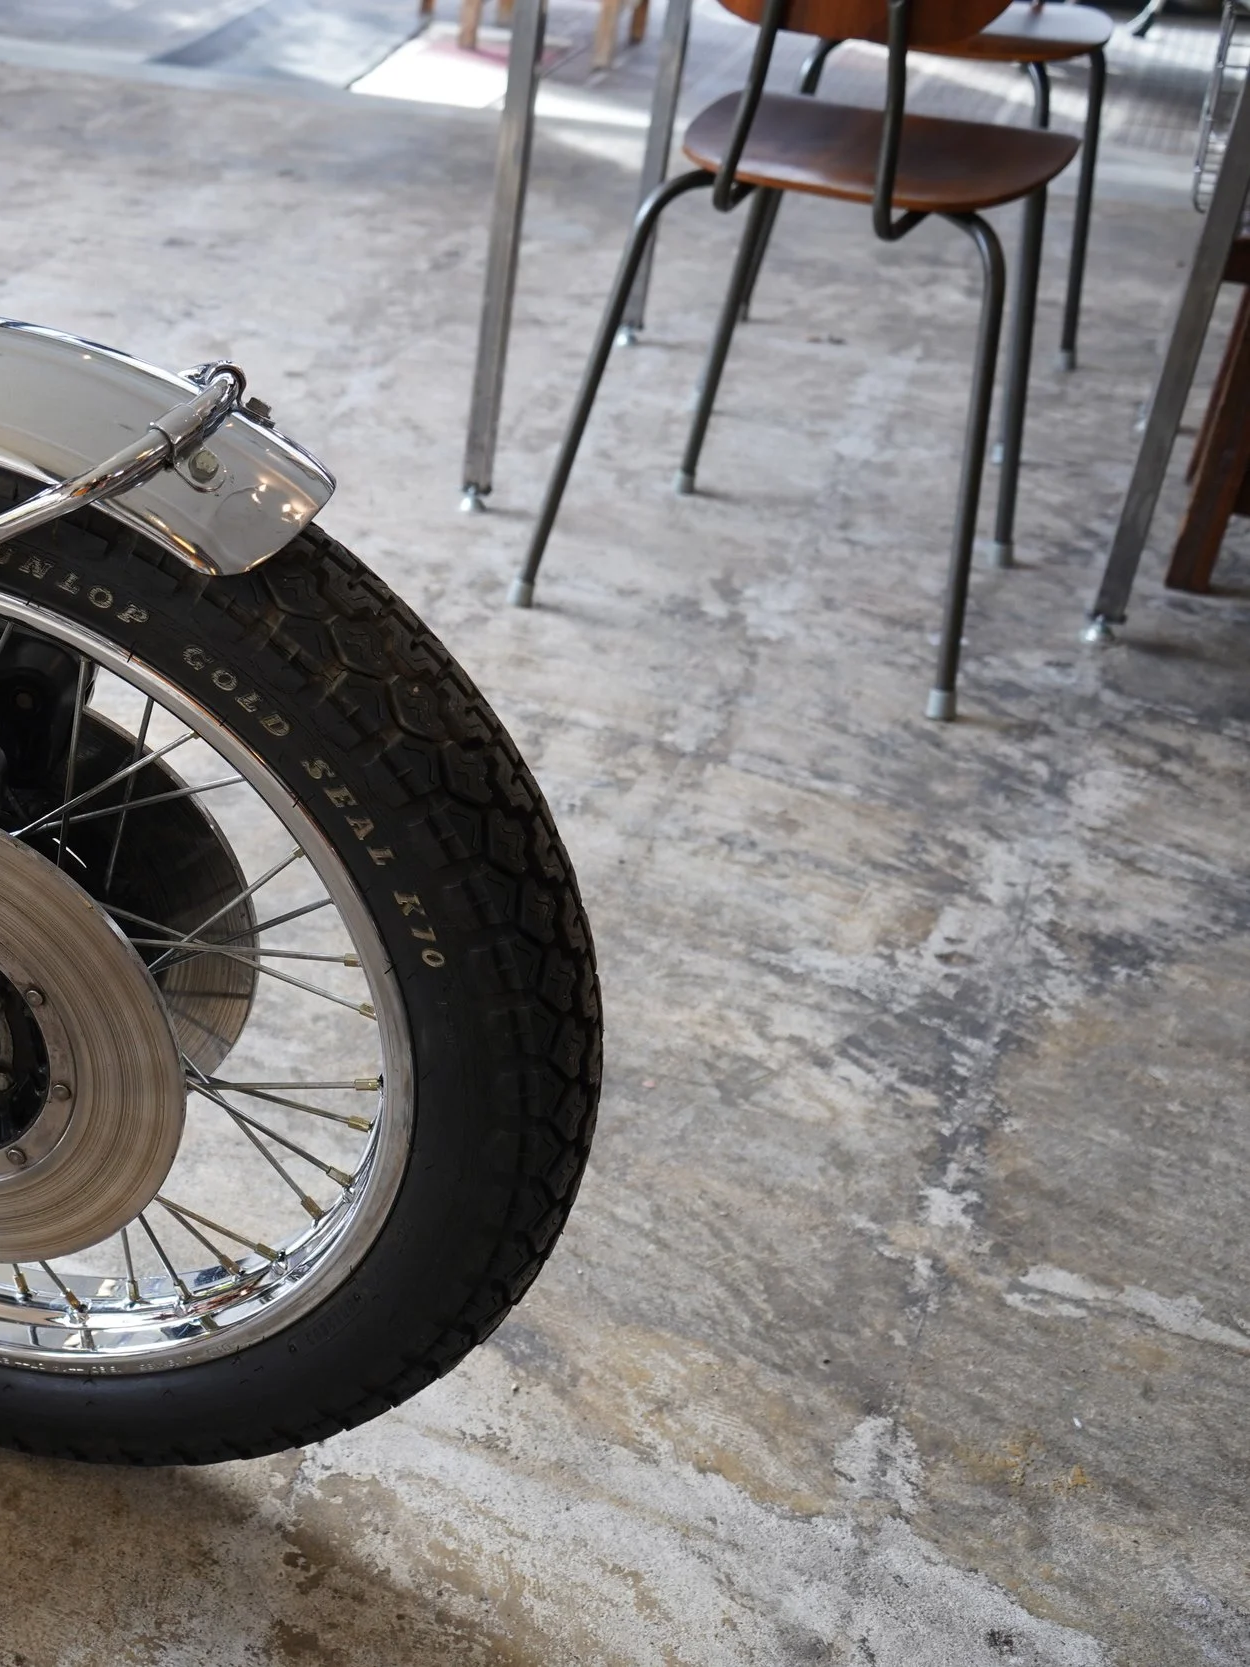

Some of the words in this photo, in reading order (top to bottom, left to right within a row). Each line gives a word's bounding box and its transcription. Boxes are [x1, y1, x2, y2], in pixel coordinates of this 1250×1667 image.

[181, 645, 293, 737] GOLD
[300, 757, 396, 866] SEAL
[393, 890, 446, 968] K70
